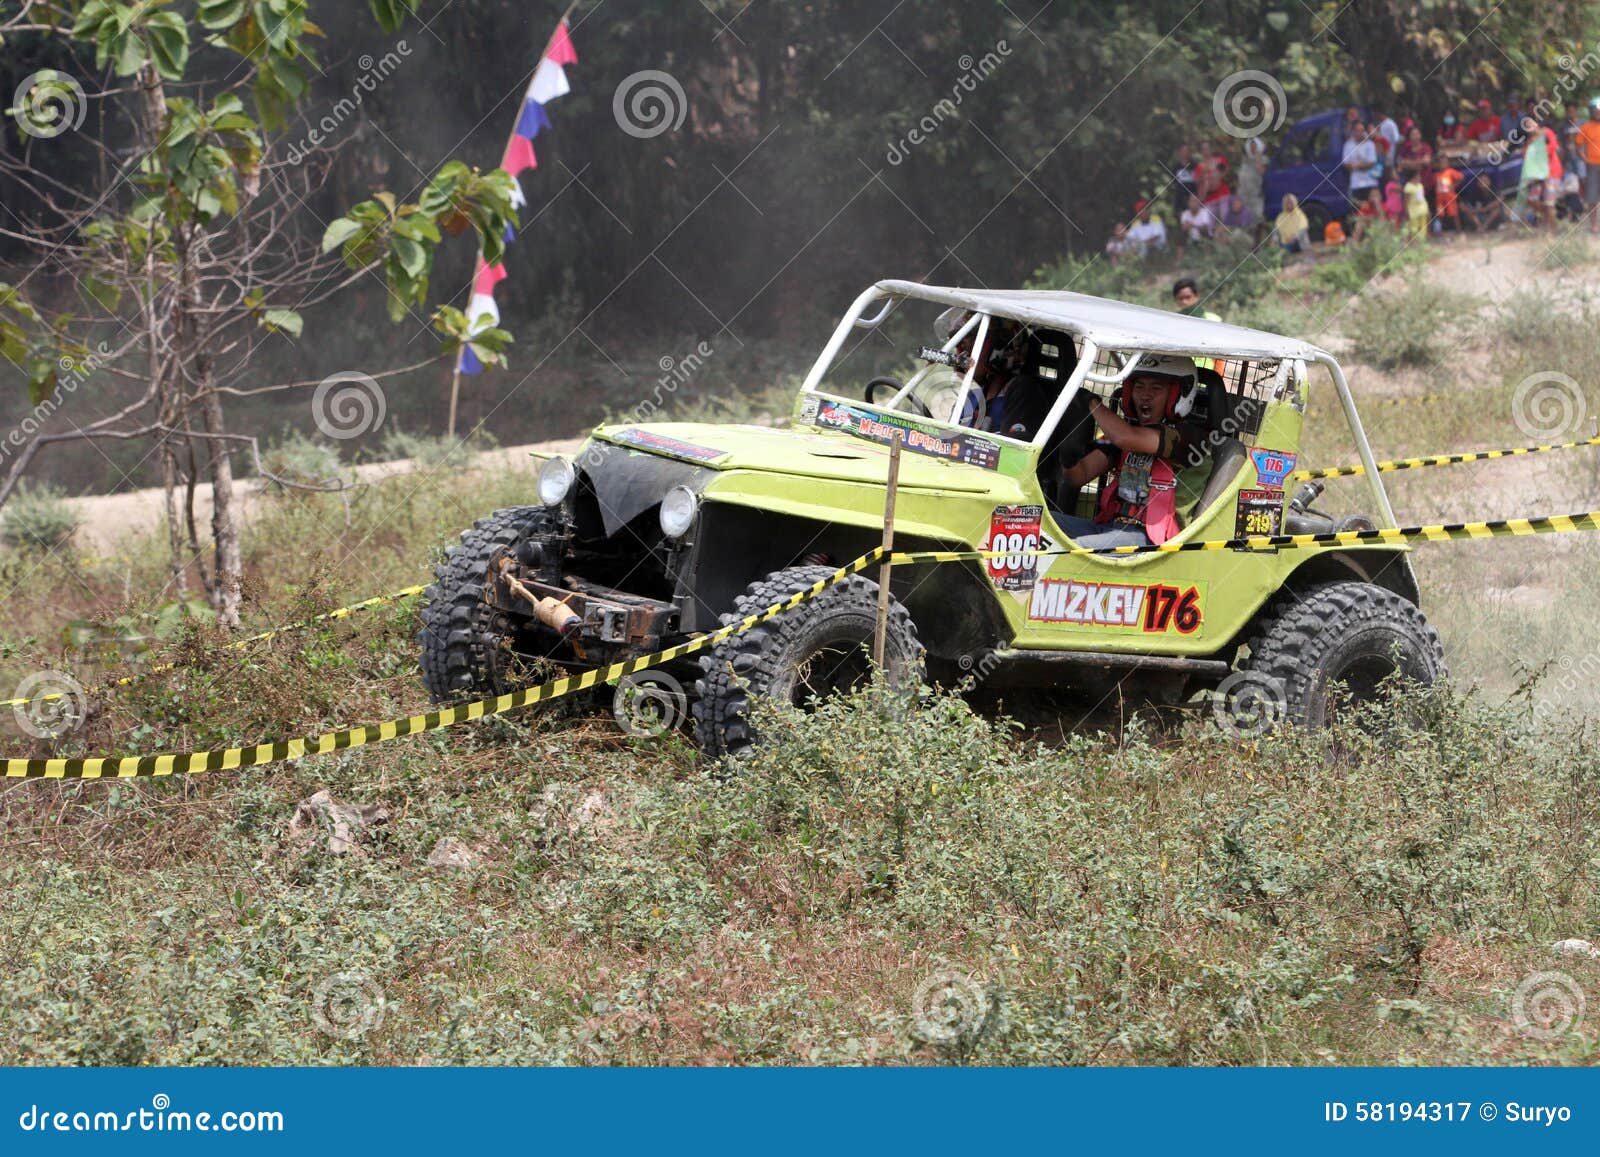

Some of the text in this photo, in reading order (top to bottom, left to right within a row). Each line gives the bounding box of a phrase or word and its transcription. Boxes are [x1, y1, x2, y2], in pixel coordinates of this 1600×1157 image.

[1264, 457, 1284, 474] 176
[1245, 513, 1271, 533] 219
[991, 533, 1038, 570] 086
[1029, 580, 1201, 634] MIZKEV 176
